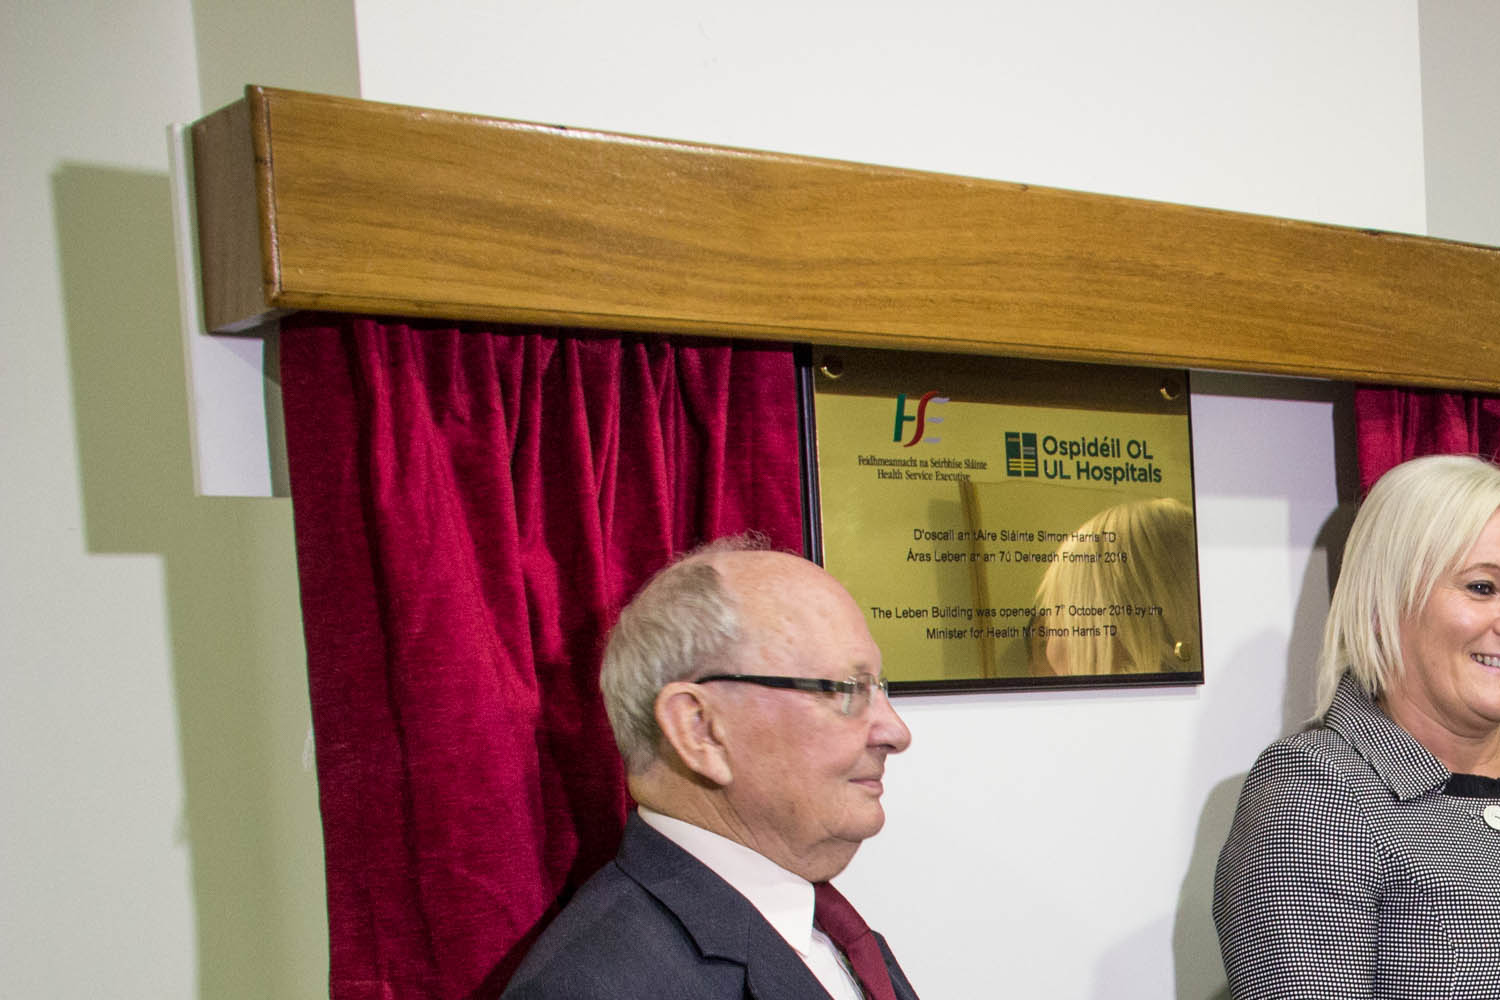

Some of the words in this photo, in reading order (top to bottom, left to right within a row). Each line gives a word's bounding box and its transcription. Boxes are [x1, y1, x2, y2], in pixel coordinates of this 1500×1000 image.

[1042, 435, 1121, 460] Ospidéil
[1126, 439, 1154, 460] OL
[877, 468, 902, 480] Health
[905, 470, 932, 480] Service
[935, 470, 971, 482] Executive
[1044, 459, 1071, 480] UL
[1076, 460, 1162, 485] Hospitals
[913, 528, 954, 541] D'oscail
[957, 531, 970, 541] an
[1037, 530, 1068, 542] Simon
[1071, 531, 1100, 543] Harris
[1102, 531, 1117, 543] TD
[934, 550, 967, 561] Leben
[983, 552, 996, 561] an
[1014, 550, 1059, 562] Deireadh
[1104, 551, 1128, 563] 2016
[871, 607, 892, 619] The
[895, 607, 928, 618] Leben
[931, 606, 973, 620] Building
[976, 608, 997, 617] was
[999, 606, 1037, 620] opened
[1039, 608, 1052, 617] on
[1068, 604, 1107, 616] October
[1109, 604, 1132, 616] 2016
[926, 627, 967, 639] Minister
[970, 626, 984, 639] for
[986, 626, 1019, 638] Health
[1038, 626, 1069, 638] Simon
[1071, 625, 1101, 637] Harris
[1103, 624, 1118, 636] TD
